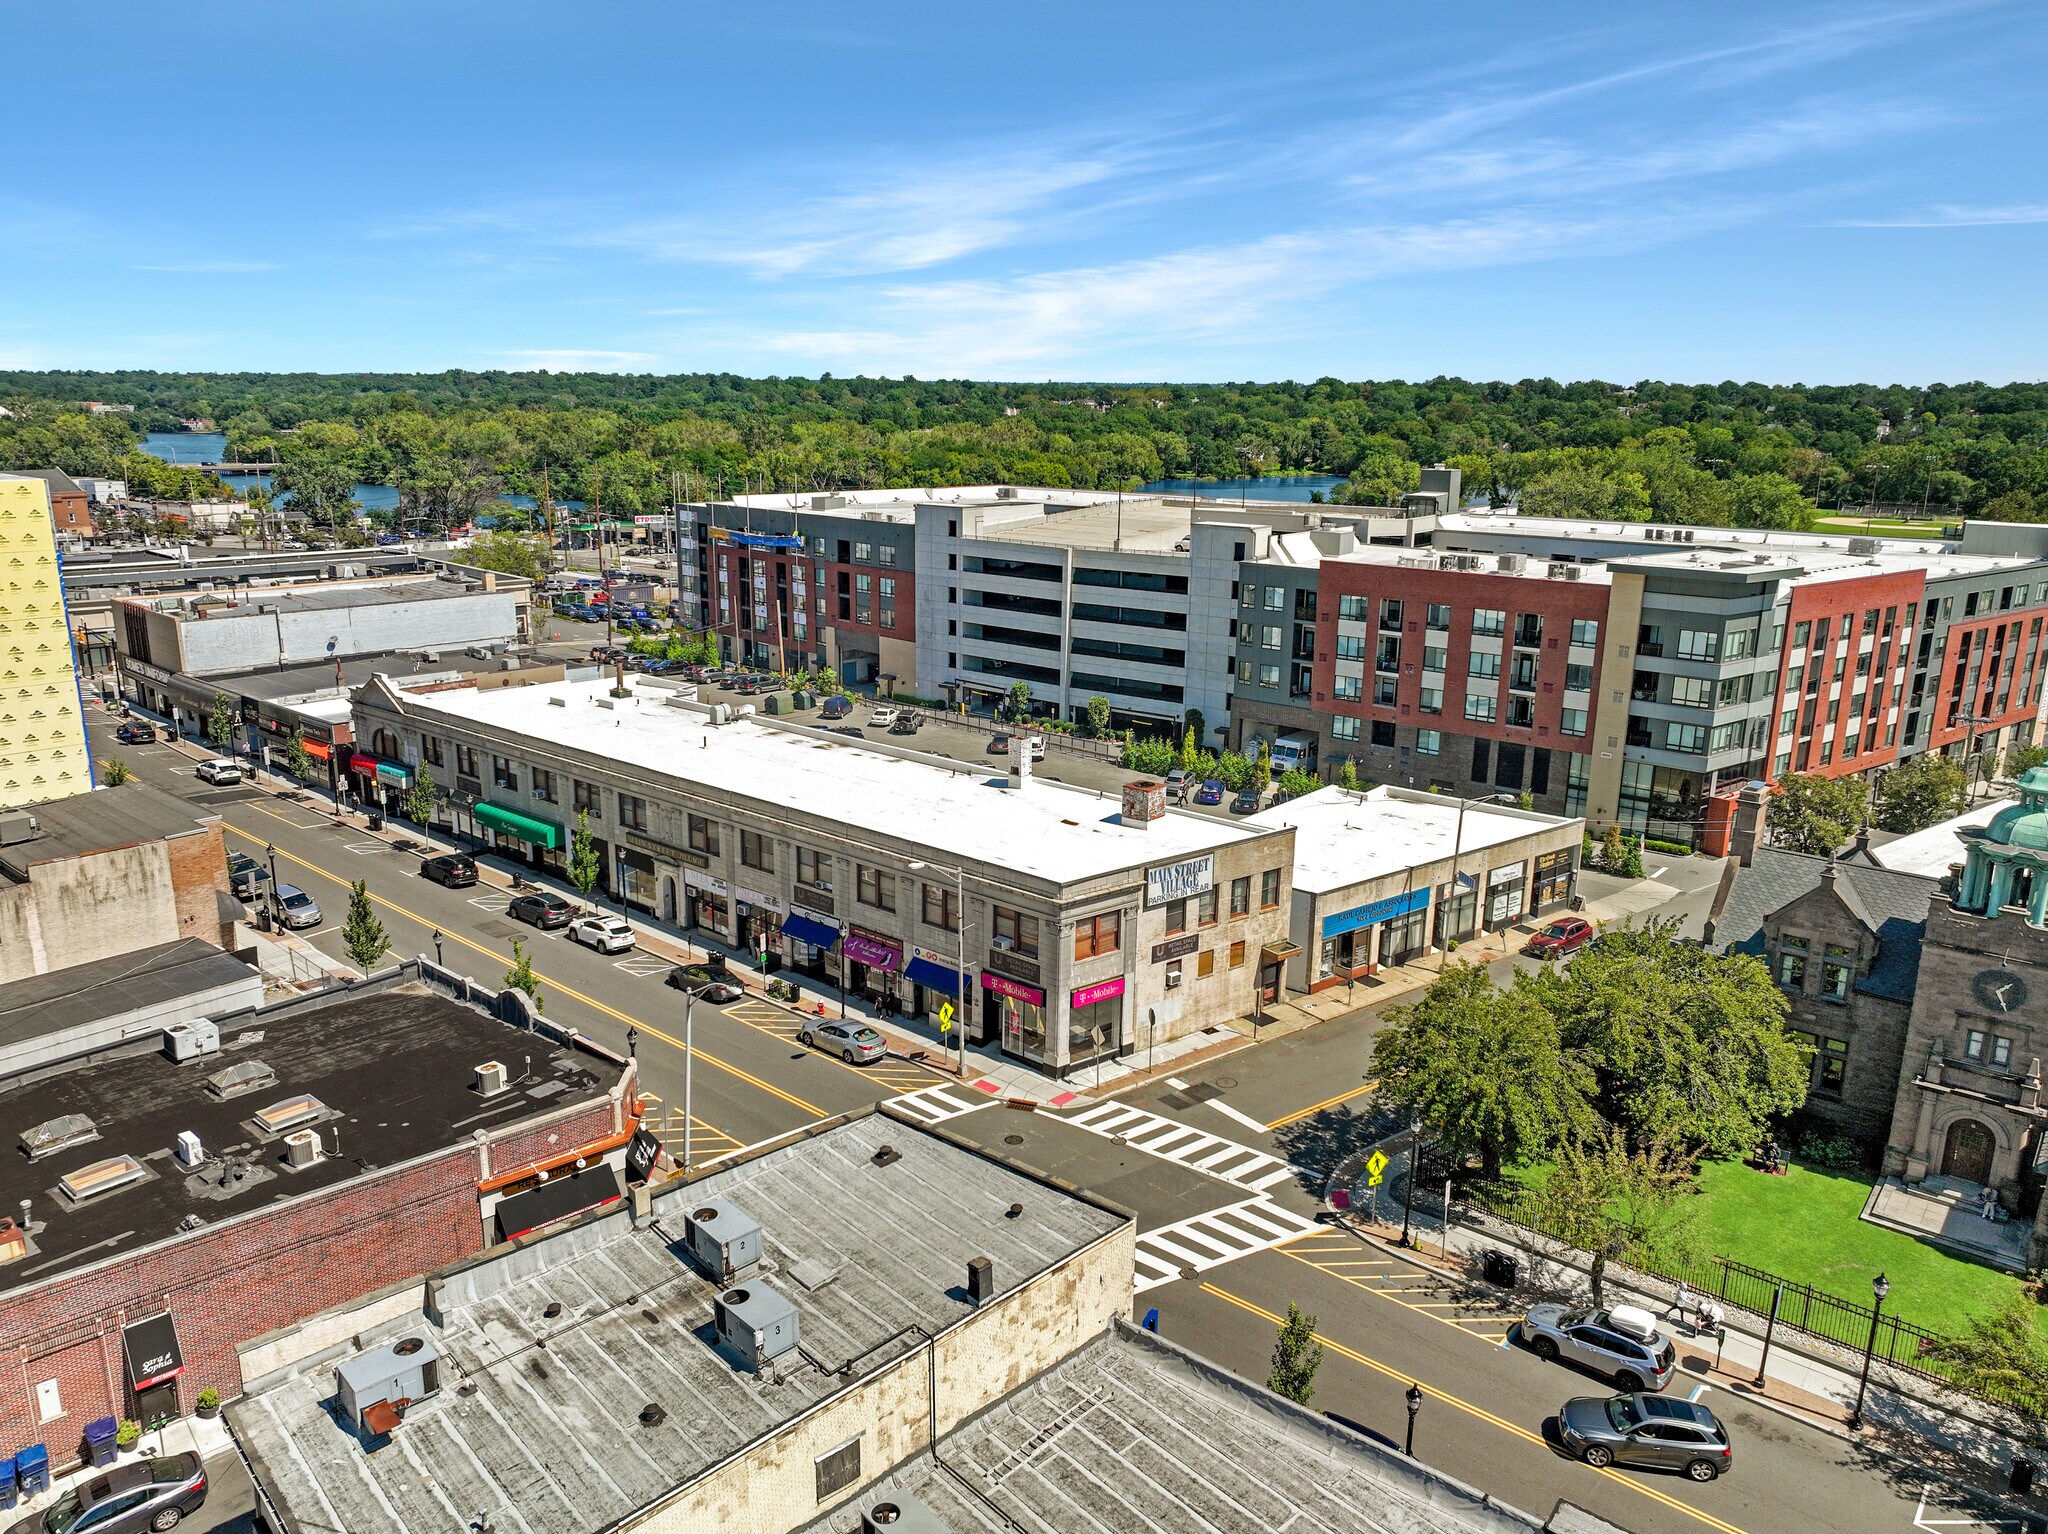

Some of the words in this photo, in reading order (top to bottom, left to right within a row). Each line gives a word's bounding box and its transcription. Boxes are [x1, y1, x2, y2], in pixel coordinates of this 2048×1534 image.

[1149, 866, 1173, 885] MAIN
[1174, 857, 1210, 879] STREET
[1160, 872, 1200, 895] VILLAGE
[1148, 890, 1179, 905] PARKING
[1180, 887, 1188, 897] IN
[1190, 883, 1210, 894] REAR
[1338, 912, 1354, 922] RAUL
[530, 1219, 556, 1232] AUTHENTIC
[555, 1209, 584, 1222] ECUADORIAN
[584, 1202, 602, 1212] CUISINE
[740, 1241, 746, 1250] 2
[775, 1325, 781, 1335] 3
[142, 1355, 164, 1367] Sara
[142, 1358, 173, 1375] Sophia
[393, 1378, 399, 1388] 1
